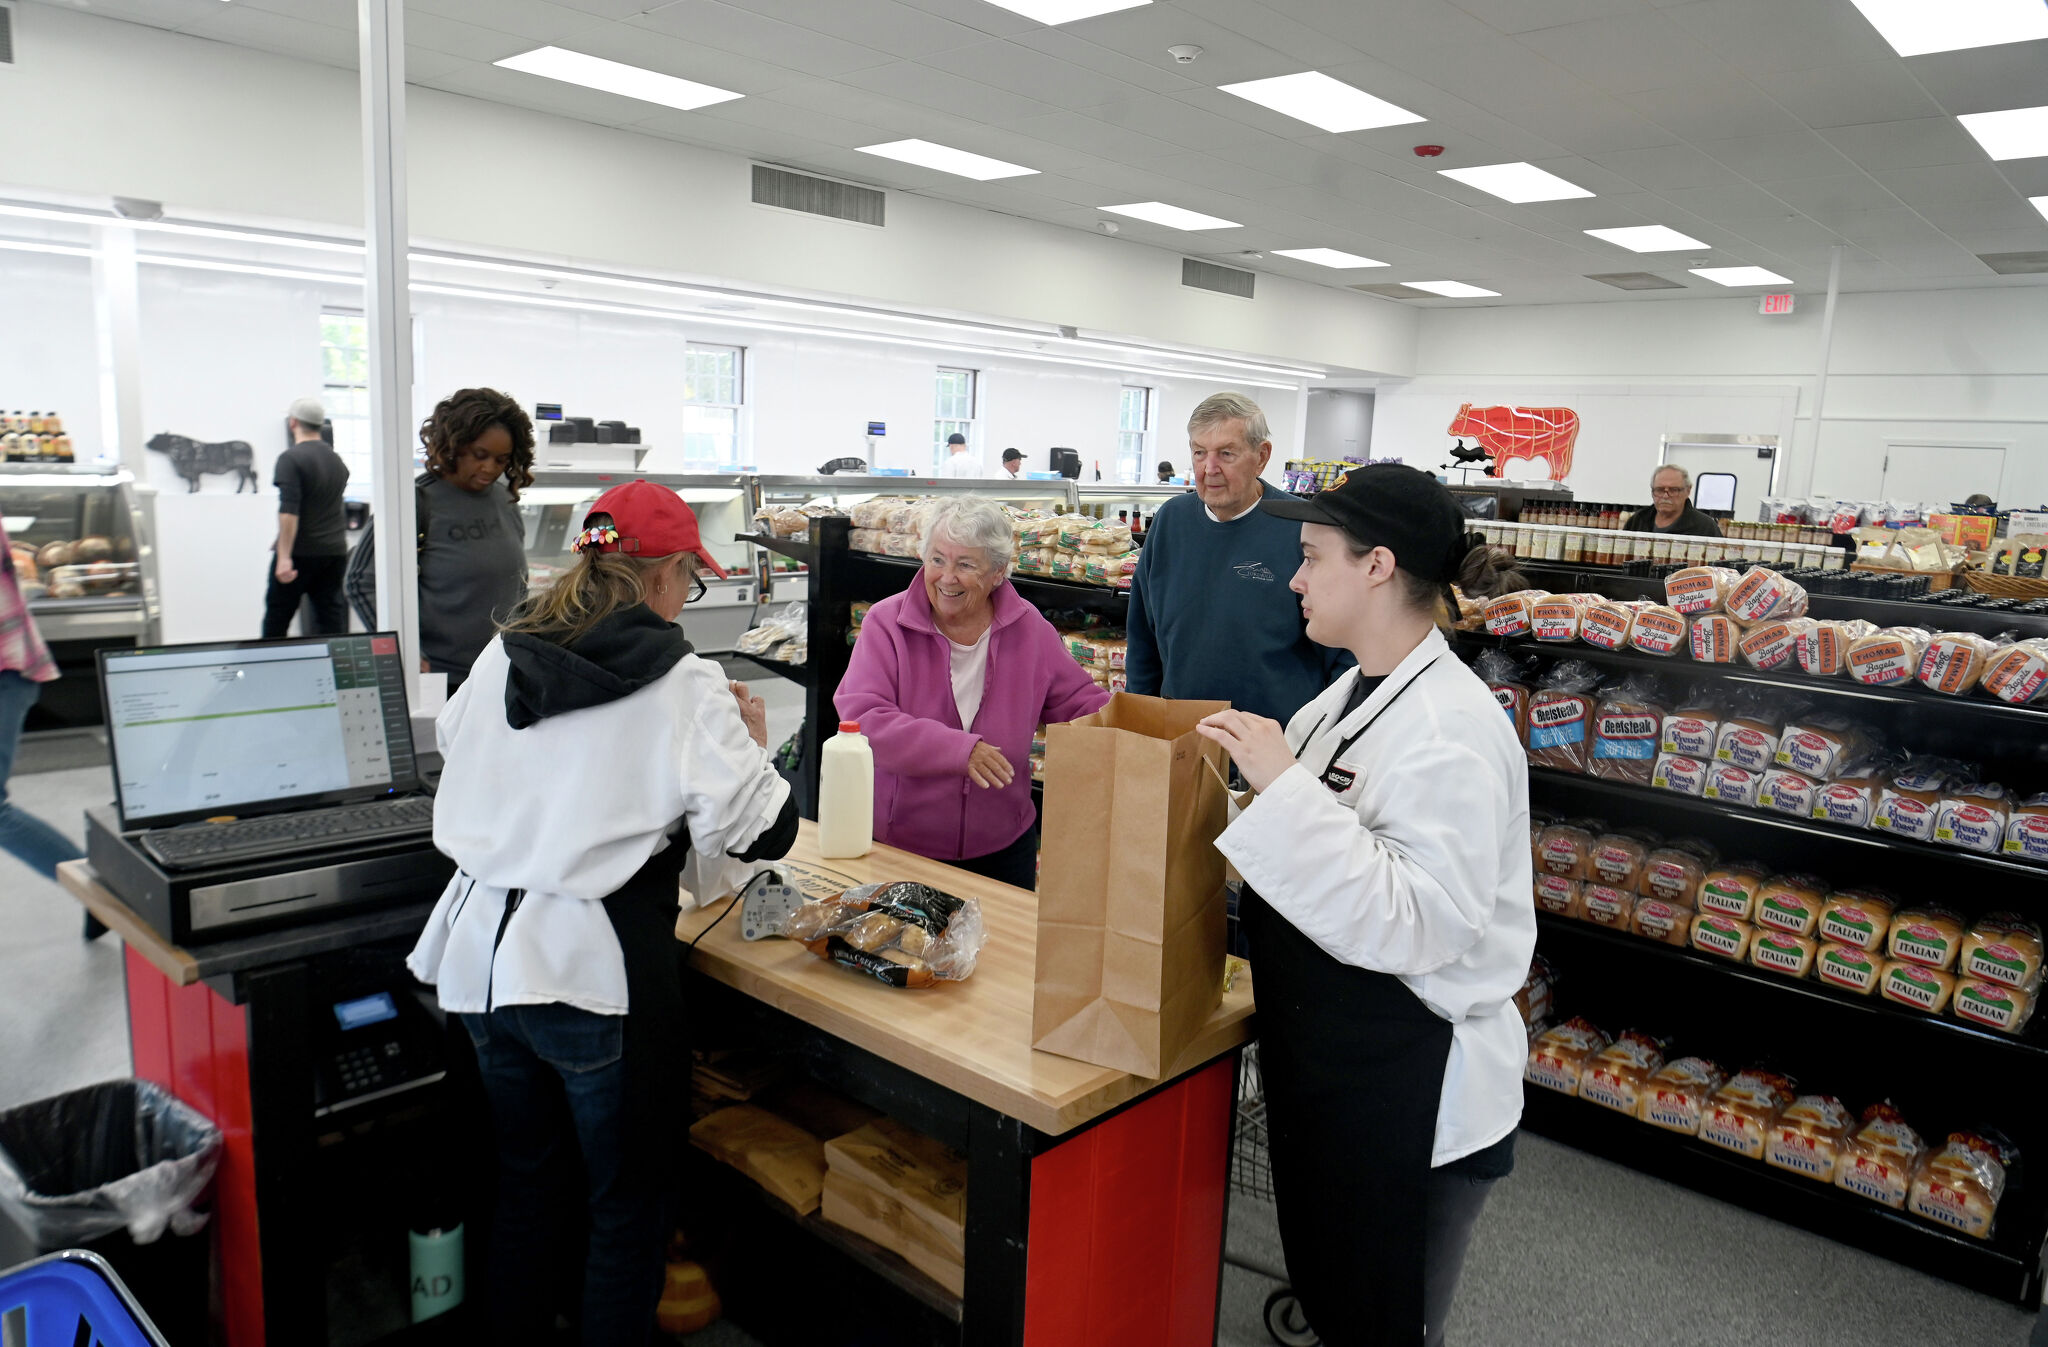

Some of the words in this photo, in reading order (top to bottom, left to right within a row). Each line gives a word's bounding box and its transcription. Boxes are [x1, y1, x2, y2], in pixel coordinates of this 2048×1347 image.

[1765, 295, 1791, 312] EXIT
[1678, 593, 1705, 603] Bagels
[1679, 601, 1706, 612] PLAIN
[1745, 587, 1767, 609] Bagels
[1754, 593, 1775, 617] PLAIN
[1494, 615, 1517, 626] Bagels
[1542, 619, 1566, 628] Bagels
[1582, 631, 1611, 645] PLAIN
[1590, 623, 1612, 636] Bagels
[1643, 627, 1668, 641] Bagels
[1639, 639, 1665, 650] PLAIN
[1703, 628, 1712, 653] Bagels
[1758, 642, 1784, 659] Bagels
[1807, 639, 1817, 664] Bagels
[1866, 660, 1895, 673] Bagels
[1933, 652, 1951, 679] Bagels
[1869, 670, 1898, 683] PLAIN
[2005, 669, 2030, 695] Bagels
[2019, 675, 2041, 700] PLAIN
[1605, 720, 1651, 734] Beefsteak
[1672, 731, 1704, 745] French
[1679, 743, 1699, 752] Toast
[1730, 739, 1761, 759] French
[1791, 743, 1821, 764] French
[1734, 753, 1754, 764] Toast
[1792, 756, 1813, 770] Toast
[1665, 767, 1695, 784] French
[1669, 779, 1689, 791] Toast
[1716, 776, 1746, 793] French
[1720, 789, 1740, 800] Toast
[1772, 784, 1804, 805] French
[1774, 797, 1797, 810] Toast
[1823, 796, 1857, 813] French
[1828, 808, 1852, 819] Toast
[1888, 806, 1923, 827] French
[1891, 819, 1917, 832] Toast
[1950, 816, 1988, 837] French
[1954, 830, 1981, 844] Toast
[1707, 895, 1742, 910] ITALIAN
[1765, 910, 1801, 928] ITALIAN
[1828, 923, 1865, 941] ITALIAN
[1700, 932, 1734, 950] ITALIAN
[1761, 948, 1797, 966] ITALIAN
[1899, 942, 1940, 960] ITALIAN
[1826, 964, 1864, 983] ITALIAN
[1975, 960, 2018, 981] ITALIAN
[1892, 981, 1931, 1002] ITALIAN
[1962, 1001, 2004, 1020] ITALIAN
[1529, 1071, 1563, 1089] WHITE
[1585, 1088, 1621, 1107] WHITE
[1651, 1111, 1690, 1126] WHITE
[1705, 1129, 1745, 1150] WHITE
[1774, 1152, 1820, 1173] WHITE
[1844, 1177, 1890, 1201] WHITE
[1917, 1202, 1968, 1228] WHITE
